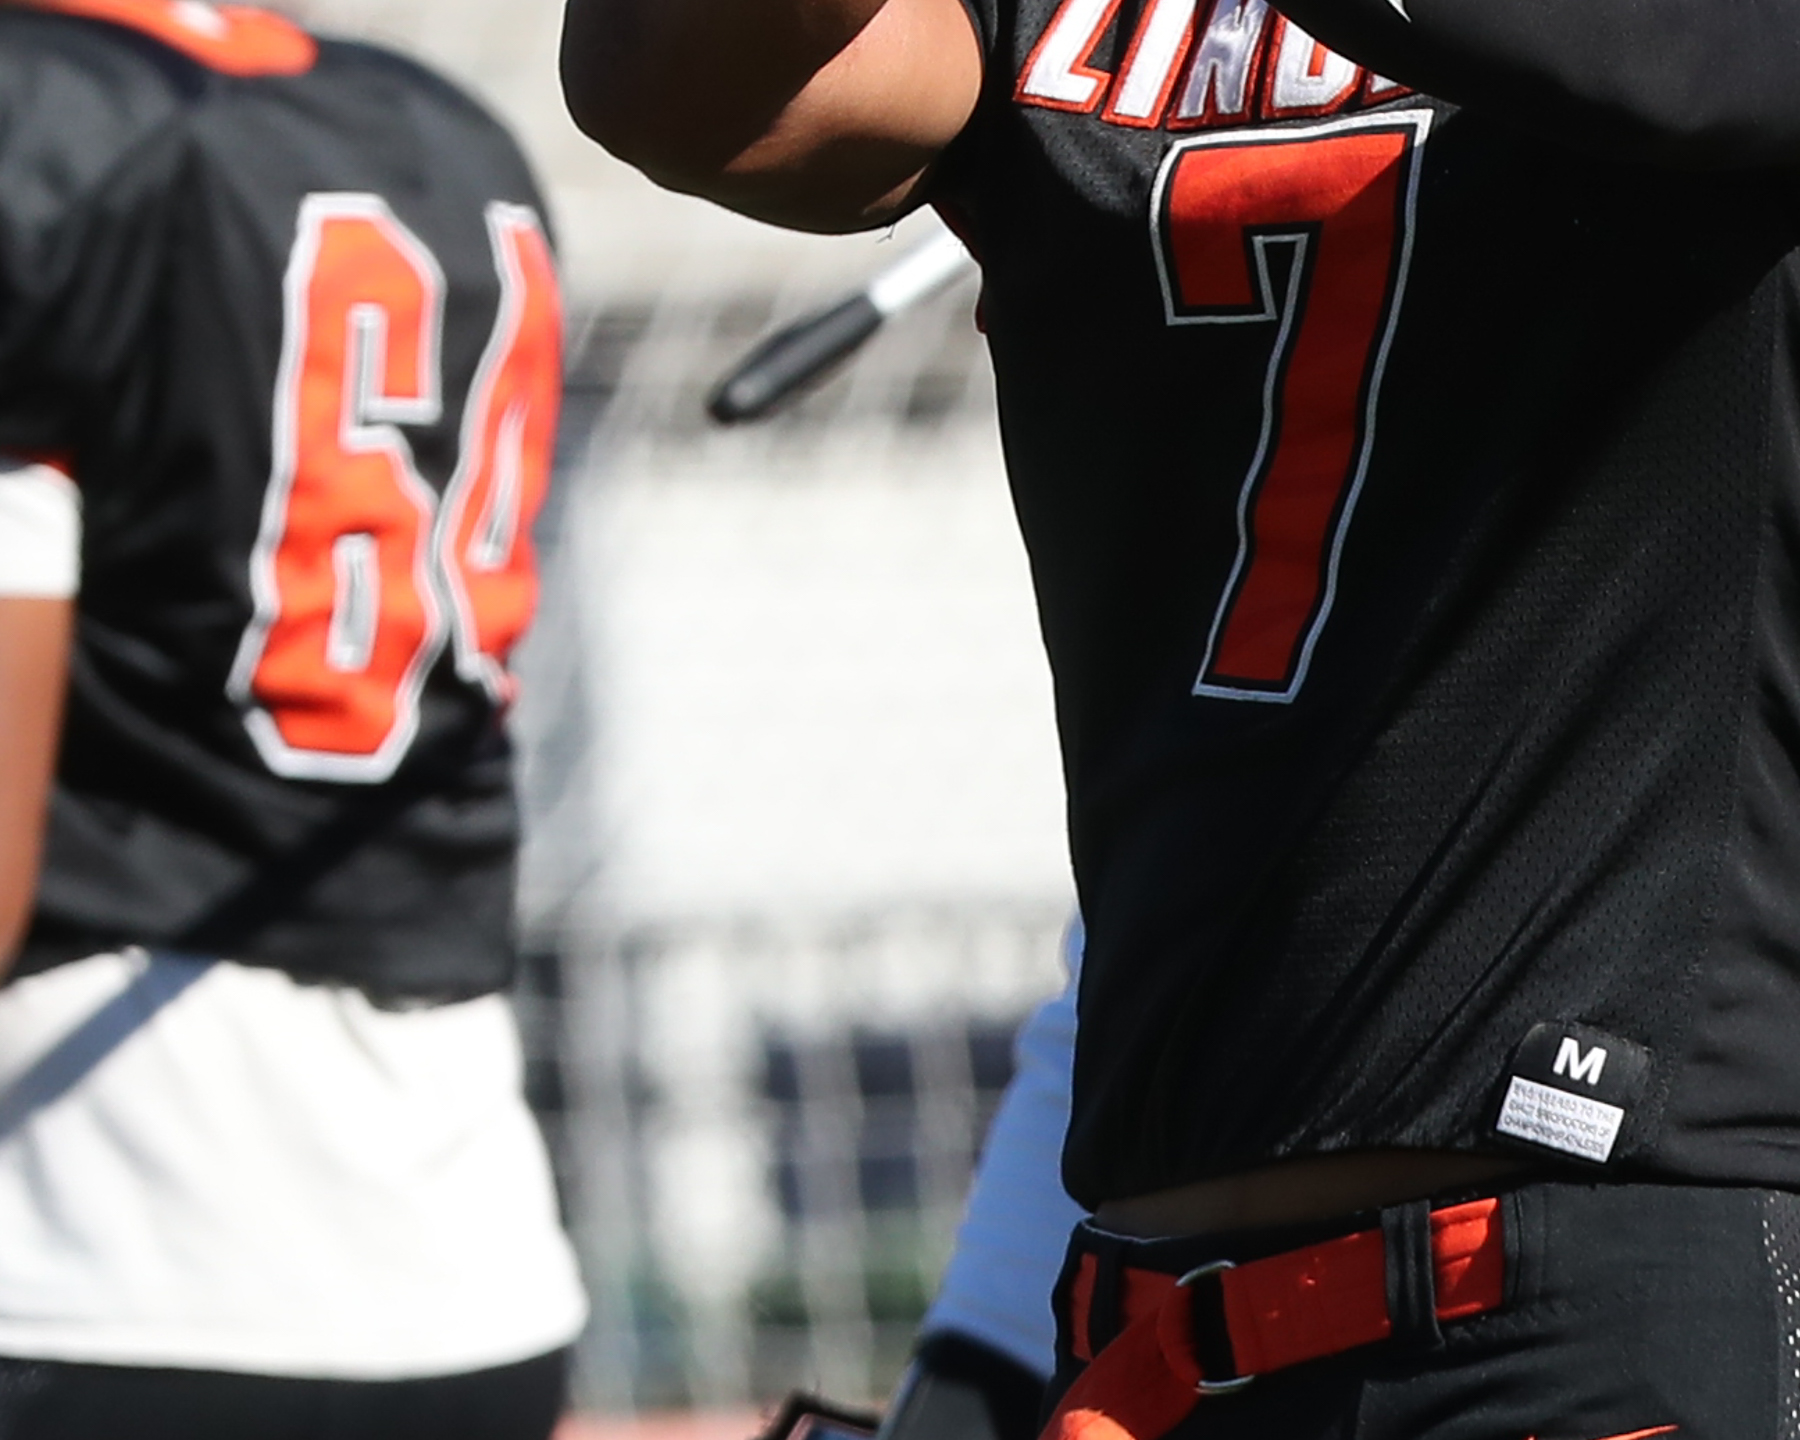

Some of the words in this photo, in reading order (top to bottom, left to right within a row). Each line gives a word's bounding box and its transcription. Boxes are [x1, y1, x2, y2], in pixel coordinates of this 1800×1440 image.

[226, 193, 565, 784] 64
[1148, 109, 1434, 703] 7
[1552, 1036, 1607, 1086] M
